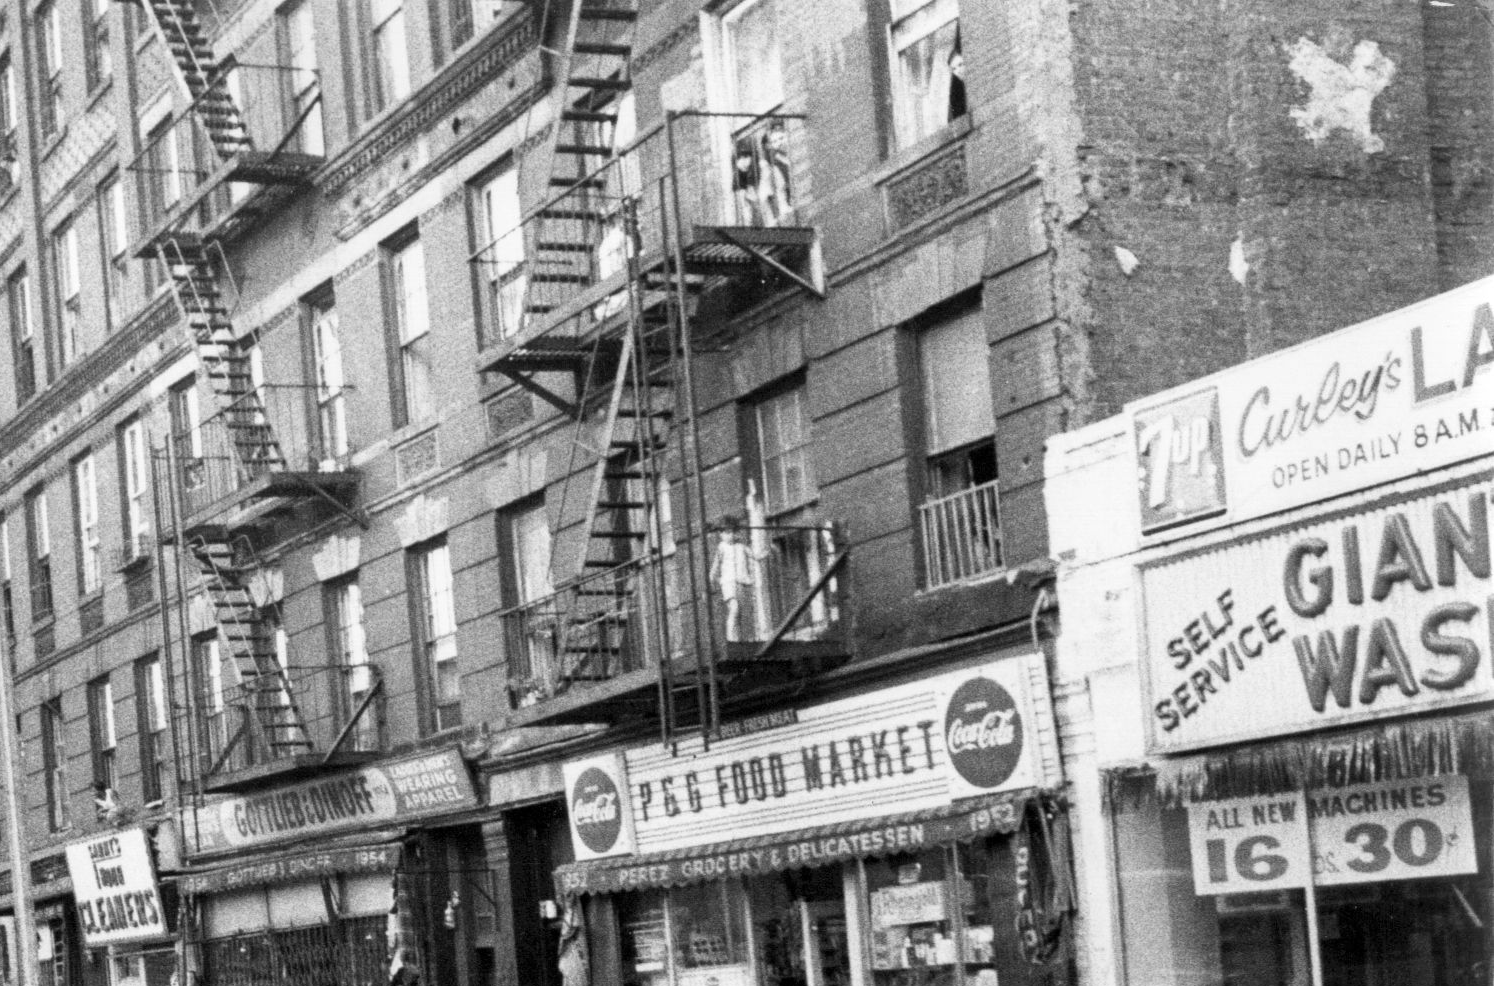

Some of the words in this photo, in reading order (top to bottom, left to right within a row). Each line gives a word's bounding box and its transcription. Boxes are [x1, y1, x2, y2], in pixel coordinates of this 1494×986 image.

[1237, 349, 1403, 459] Curley's
[1271, 453, 1329, 490] OPEN
[1338, 431, 1403, 471] DAILY
[1414, 423, 1429, 449] 8
[1283, 490, 1494, 620] GIAN
[1167, 587, 1236, 671] SELF
[1154, 603, 1287, 732] SERVICE
[947, 707, 1016, 754] Coca-Cola
[394, 768, 458, 794] WEARING
[715, 752, 786, 808] FOOD
[801, 719, 939, 793] MARKET
[234, 790, 307, 838] GOTTLIEB
[404, 785, 465, 810] APPAREL
[1205, 806, 1245, 830] ALL
[1251, 800, 1298, 826] NEW
[1306, 783, 1446, 820] MACHINES
[618, 864, 670, 886] PEREZ
[680, 852, 766, 879] GROCERY
[787, 823, 924, 863] DELICATESSEN
[1204, 833, 1290, 885] 16
[78, 889, 159, 935] CLEANERS
